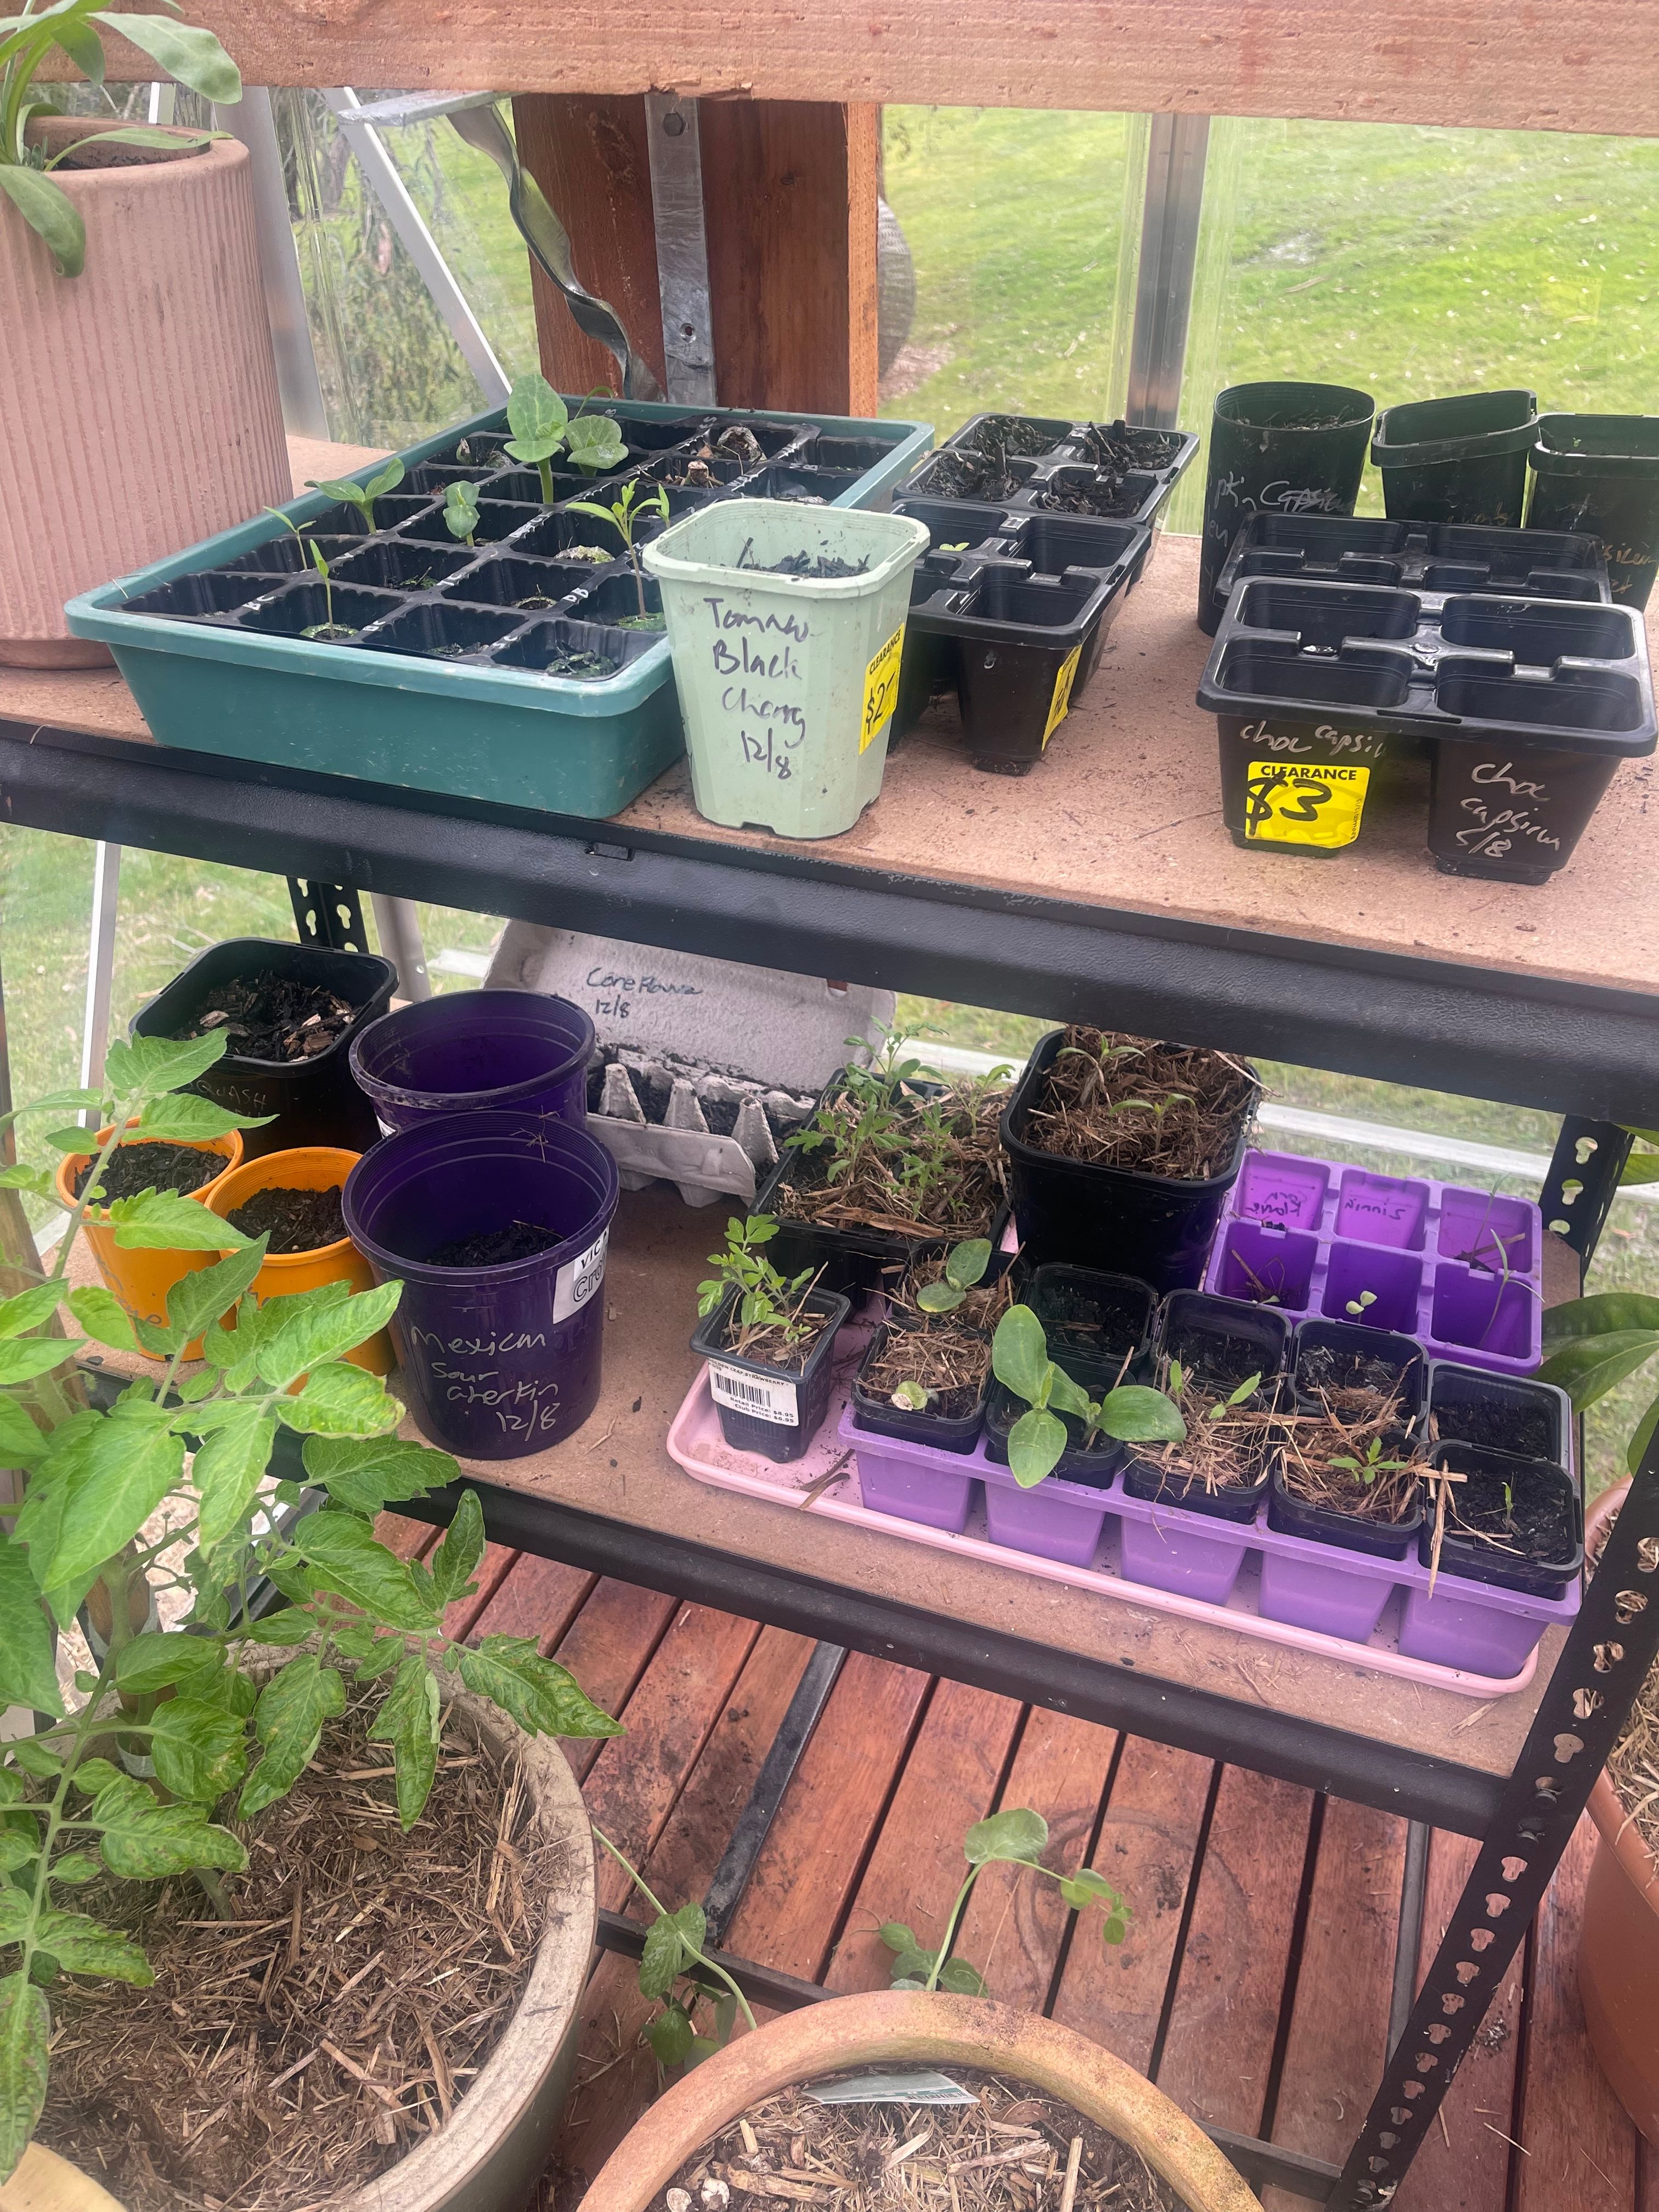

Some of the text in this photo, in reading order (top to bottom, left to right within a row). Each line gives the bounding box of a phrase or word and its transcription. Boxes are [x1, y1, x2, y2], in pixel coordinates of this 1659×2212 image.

[713, 636, 802, 680] Black
[869, 629, 901, 675] CLEARANCE
[741, 727, 792, 780] 12/8
[1260, 765, 1357, 781] CLEARANCE
[1245, 769, 1333, 838] $3
[595, 994, 631, 1019] 12/8
[581, 1239, 601, 1269] VIC
[707, 1357, 729, 1370] GOLDEN
[744, 1373, 785, 1386] STRAWBERRY
[730, 1396, 749, 1407] Retail
[751, 1403, 771, 1413] Price:
[735, 1403, 750, 1412] Club
[752, 1409, 771, 1418] Price:
[495, 1399, 561, 1442] 12/8
